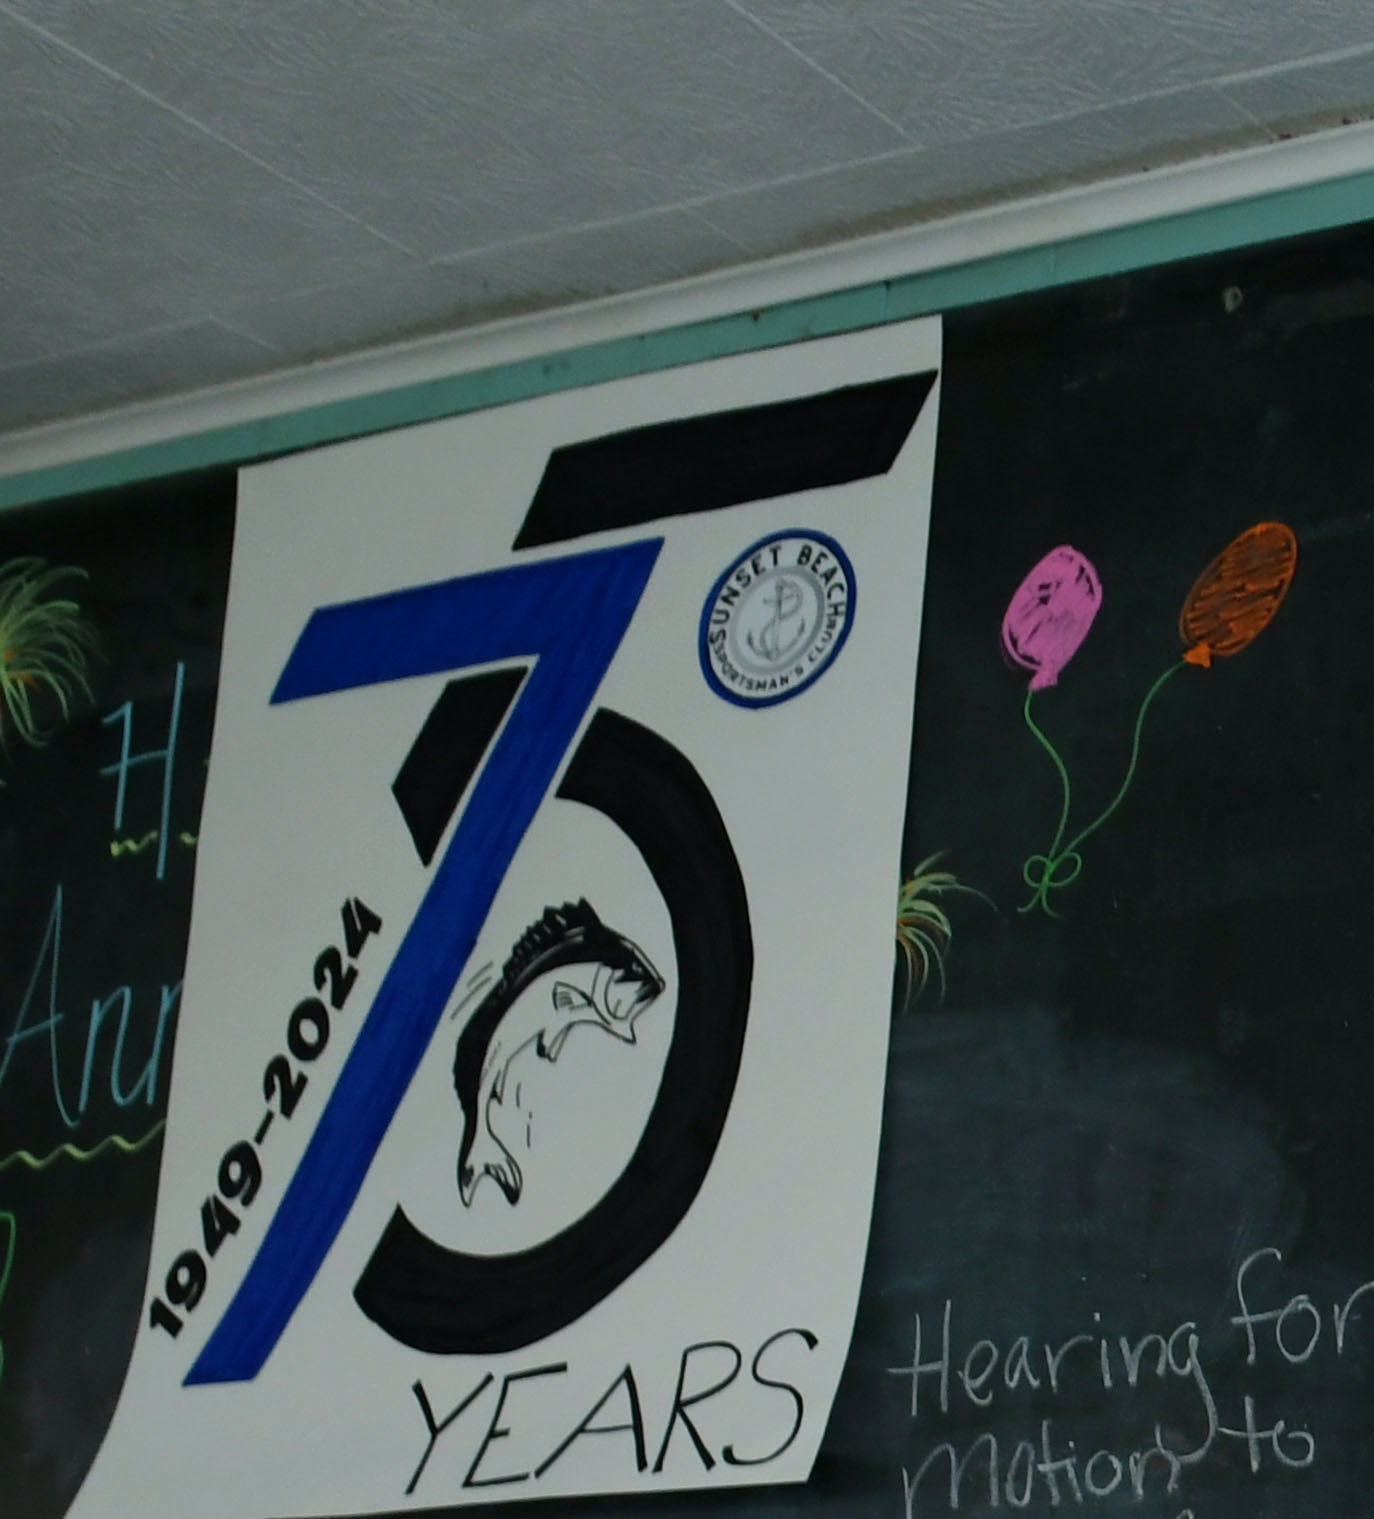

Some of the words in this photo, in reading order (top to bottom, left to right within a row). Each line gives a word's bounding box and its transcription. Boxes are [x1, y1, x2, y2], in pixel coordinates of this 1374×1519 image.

[709, 545, 782, 645] SUNSET
[796, 544, 846, 618] BEACH
[149, 897, 384, 1340] 1949-2024
[405, 1329, 819, 1495] YEARS
[887, 1299, 1218, 1462] Hearing
[1217, 1395, 1315, 1473] to
